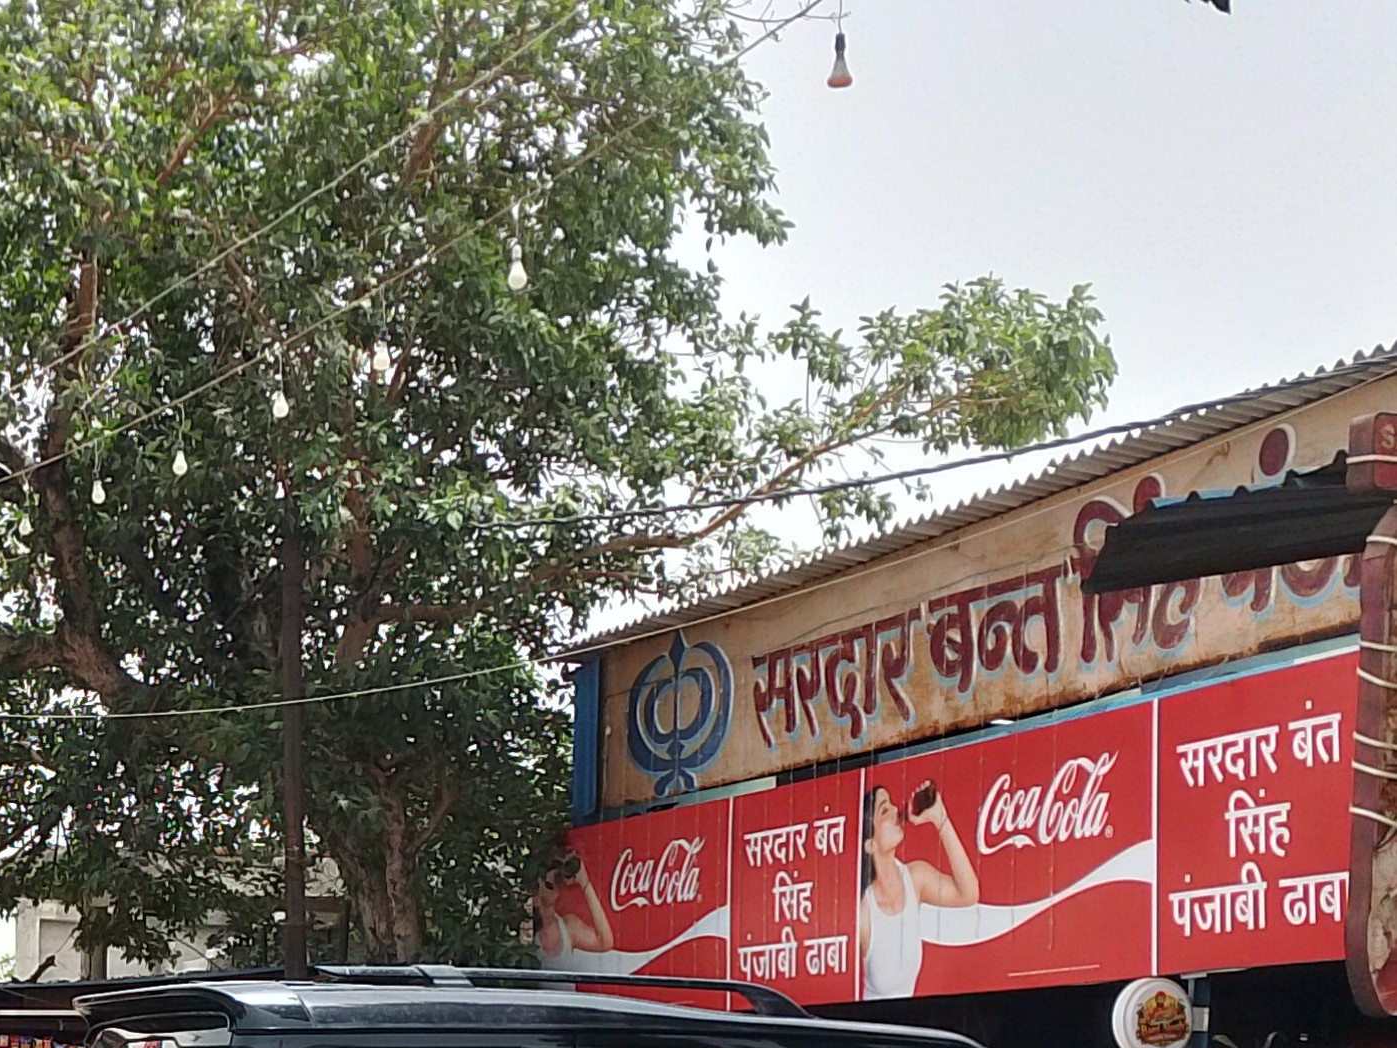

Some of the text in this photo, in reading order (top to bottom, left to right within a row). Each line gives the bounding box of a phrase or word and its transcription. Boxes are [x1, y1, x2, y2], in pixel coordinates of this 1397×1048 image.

[751, 603, 924, 748] सरदार
[1176, 700, 1342, 788] सरदार बंत
[743, 804, 847, 868] सरदार बंत
[1225, 788, 1292, 859] सिंह
[772, 870, 814, 924] सिंह
[1169, 861, 1268, 937] पंजाबी
[738, 926, 849, 982] पंजाबी ढाबा
